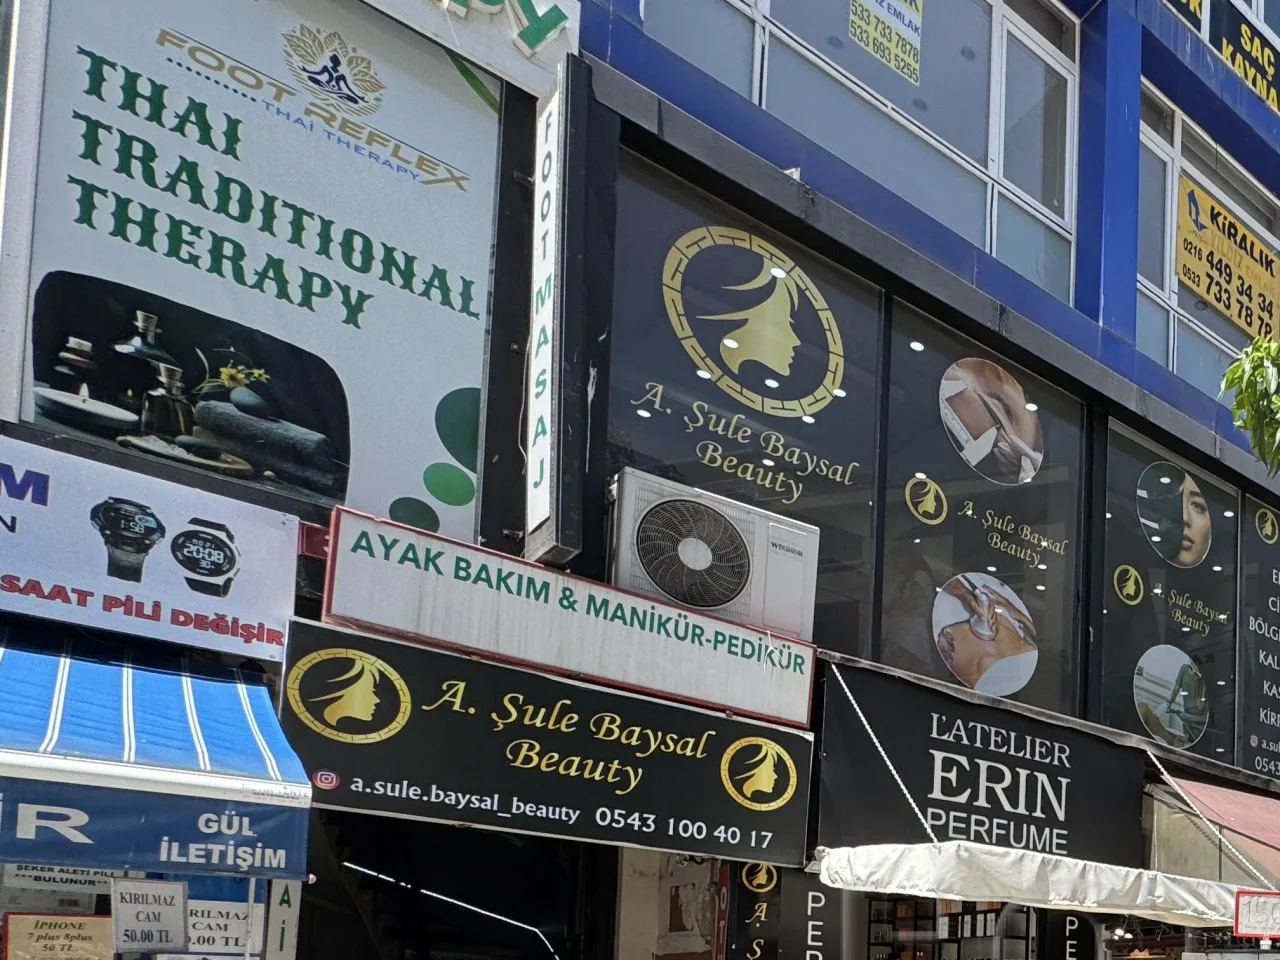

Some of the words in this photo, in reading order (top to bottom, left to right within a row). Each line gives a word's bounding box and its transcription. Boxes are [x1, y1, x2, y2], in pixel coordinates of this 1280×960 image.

[873, 15, 893, 43] 733
[895, 31, 919, 64] 7878
[887, 2, 920, 37] EMLAK
[155, 27, 298, 102] FOOT
[850, 19, 870, 47] 533
[872, 37, 892, 64] 693
[894, 52, 919, 84] 5255
[1240, 23, 1276, 81] SAÇ
[76, 45, 244, 161] THAI
[304, 101, 472, 193] REFLEX
[322, 127, 421, 181] THERAPY
[71, 109, 481, 320] TRADITIONAL
[539, 121, 553, 262] FOOT
[67, 174, 375, 330] THERAPY
[1183, 238, 1203, 262] 0216
[1206, 250, 1232, 286] 449
[1236, 274, 1253, 304] 34
[1257, 292, 1273, 320] 34
[1182, 263, 1201, 288] 0533
[1205, 272, 1232, 311] 733
[1236, 298, 1253, 328] 78
[531, 272, 553, 489] MASAJ
[630, 381, 672, 415] A.
[683, 401, 752, 443] Şule
[760, 430, 860, 486] Baysal
[696, 440, 803, 505] Beauty
[982, 509, 1015, 533] Şule
[1018, 524, 1069, 555] Baysal
[987, 532, 1041, 568] Beauty
[0, 574, 95, 609] SAAT
[102, 594, 162, 623] PİLİ
[171, 608, 285, 646] DEĞİŞİR
[351, 530, 444, 577] AYAK
[453, 562, 551, 606] BAKIM
[558, 588, 578, 612] &
[585, 592, 806, 676] MANİKÜR-PEDİKÜR
[1167, 589, 1192, 608] Şule
[1171, 608, 1210, 637] Beauty
[421, 680, 476, 715] A.
[490, 692, 578, 734] Şule
[587, 712, 717, 759] Baysal
[505, 738, 644, 796] Beauty
[927, 749, 1072, 822] ERIN
[197, 809, 258, 837] GÜL
[350, 774, 581, 825] a.sule.baysal_beauty
[595, 806, 657, 833] 0543
[667, 817, 707, 841] 100
[712, 823, 741, 846] 40
[749, 829, 774, 850] 17
[926, 807, 1069, 855] PERFUME
[32, 874, 97, 887] BULUNUR
[159, 836, 286, 871] İLETİŞİM
[33, 919, 86, 931] İPHONE
[119, 891, 176, 907] KIRILMAZ
[135, 910, 162, 923] CAM
[189, 909, 250, 922] RILMAZ
[192, 921, 229, 933] CAM
[35, 932, 61, 944] plus
[122, 928, 154, 944] 50.00
[157, 928, 174, 944] TL
[222, 936, 246, 948] TL
